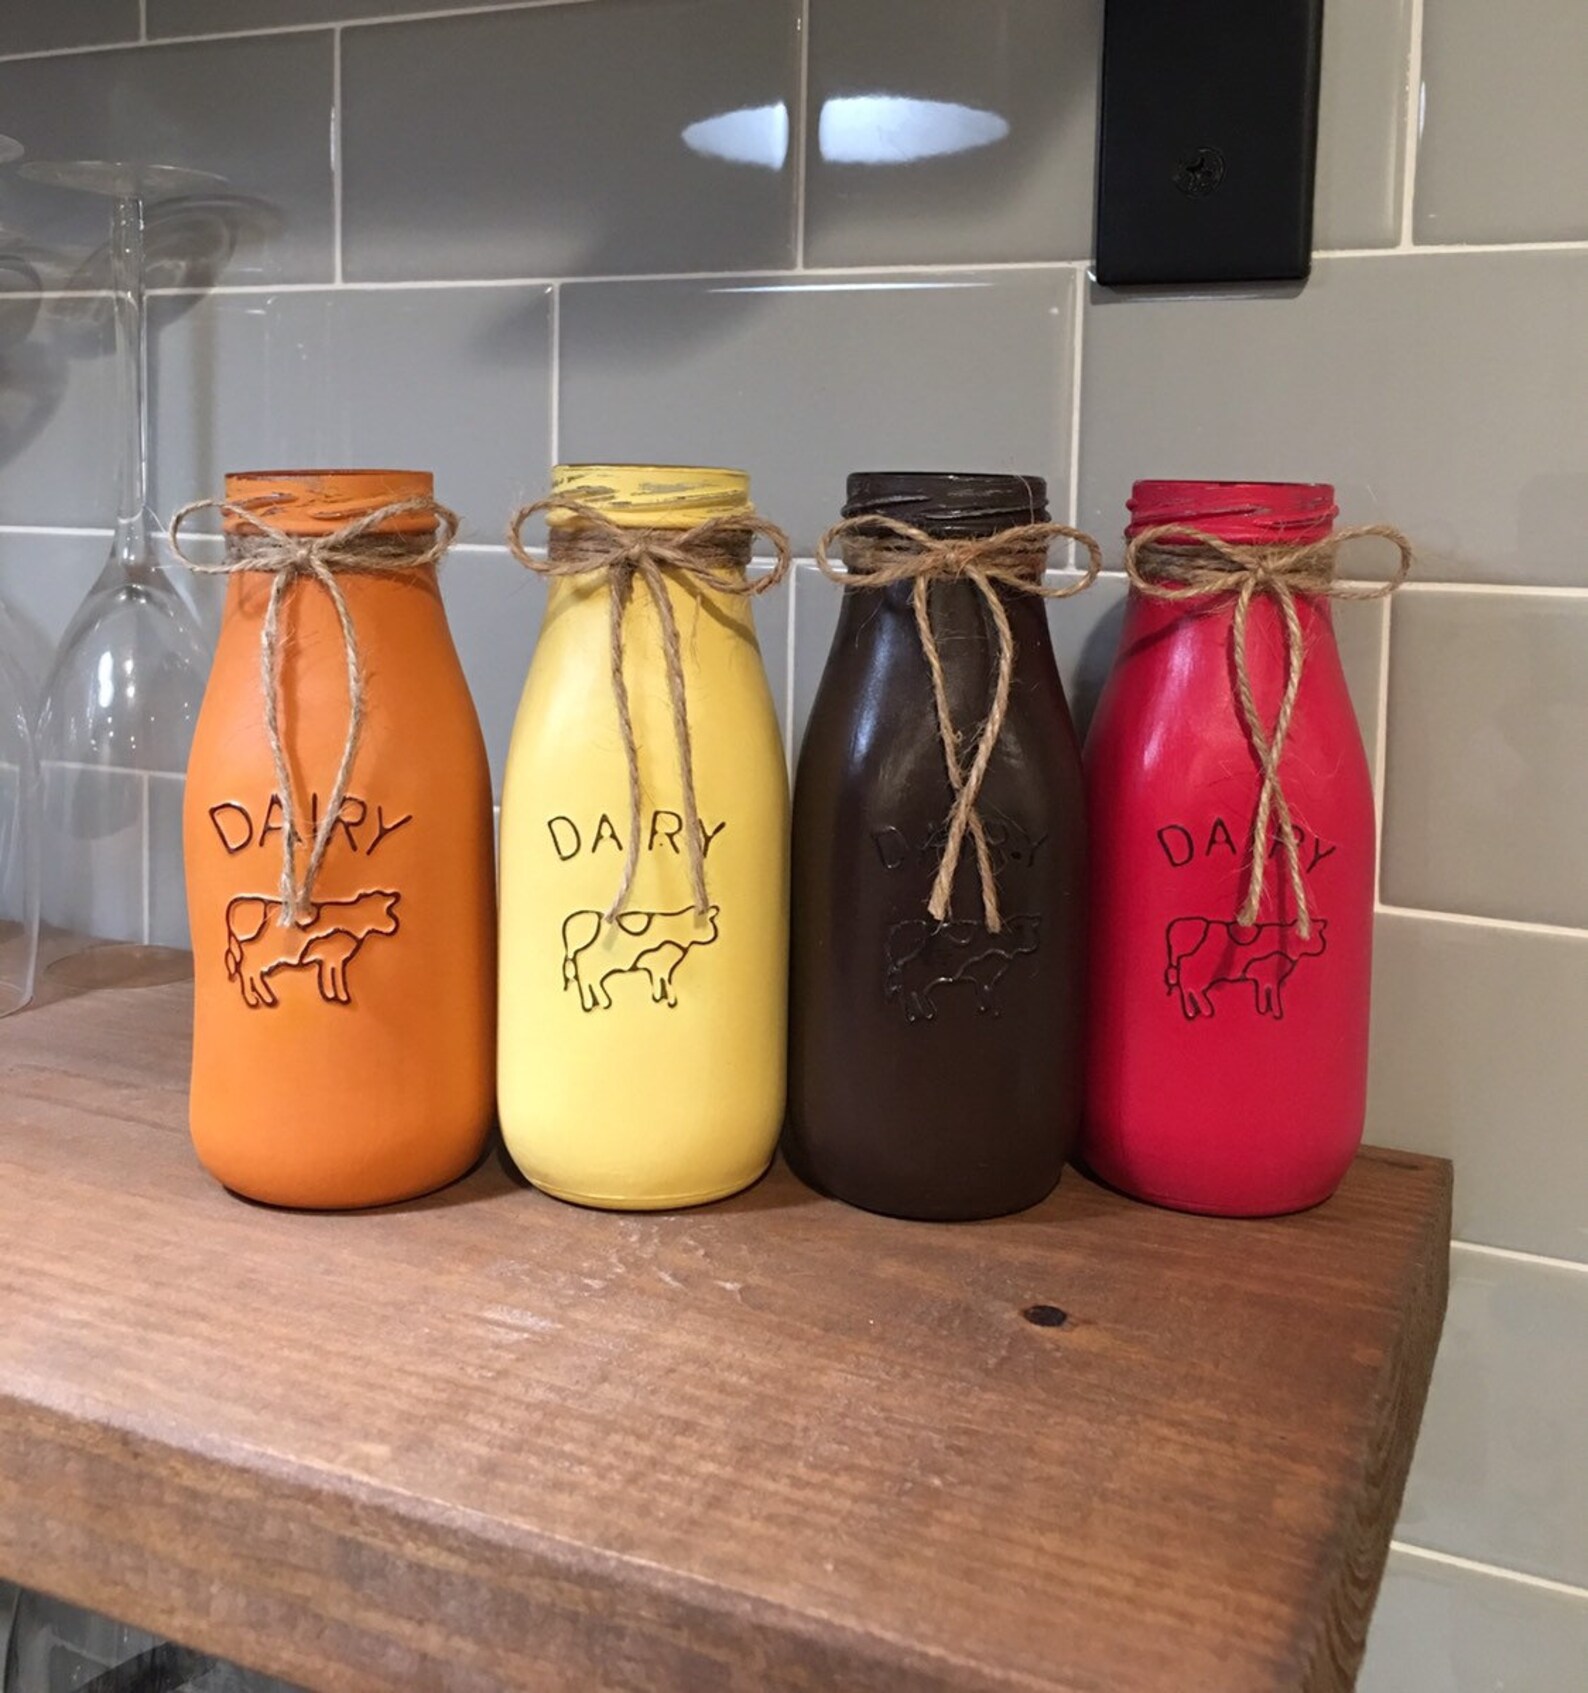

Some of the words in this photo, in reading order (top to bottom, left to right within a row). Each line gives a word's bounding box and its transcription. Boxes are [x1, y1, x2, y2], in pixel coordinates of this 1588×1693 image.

[208, 792, 413, 855] DAIRY
[547, 810, 726, 862] DARY
[1157, 817, 1337, 874] DARY
